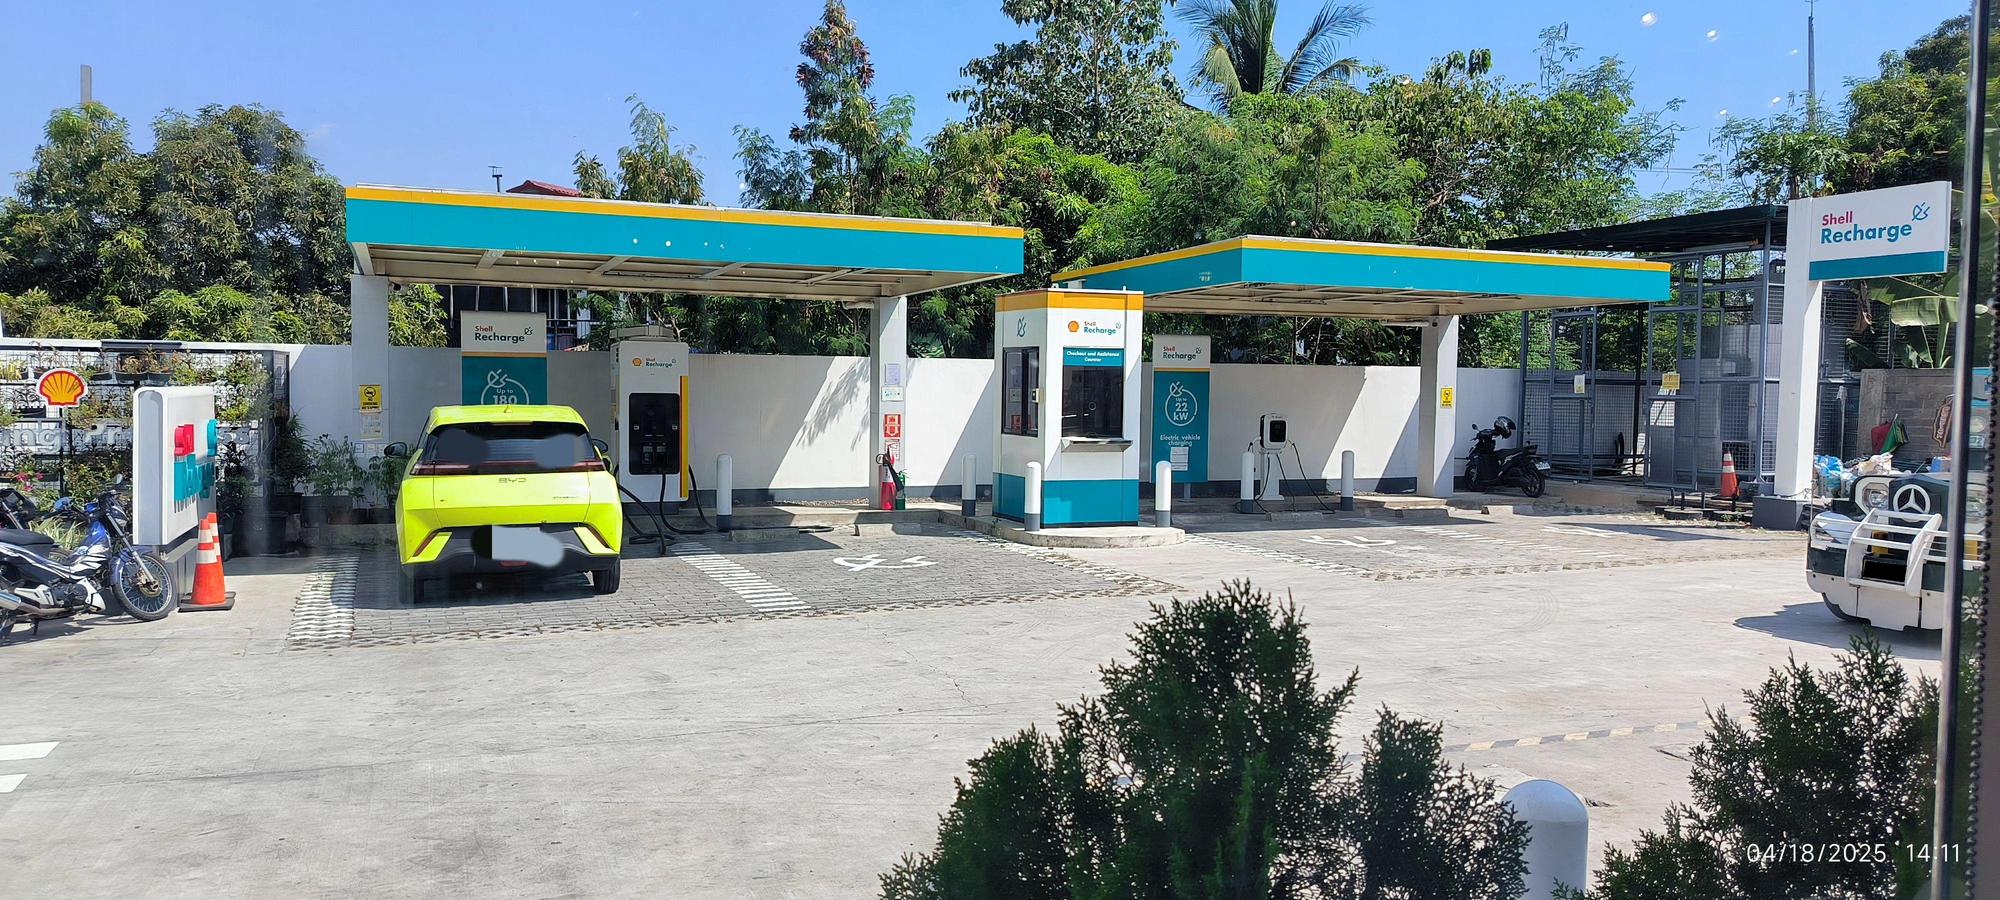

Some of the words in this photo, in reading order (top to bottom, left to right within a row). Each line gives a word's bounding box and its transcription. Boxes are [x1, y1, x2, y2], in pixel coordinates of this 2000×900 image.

[1822, 211, 1853, 226] Shell
[1820, 223, 1913, 244] Recharge
[475, 325, 494, 333] Shell
[1083, 326, 1116, 335] Recharge
[474, 332, 525, 344] Recharge
[1162, 352, 1197, 361] Recharge
[492, 395, 518, 404] 180
[1175, 402, 1188, 411] 22
[1173, 412, 1189, 420] kW
